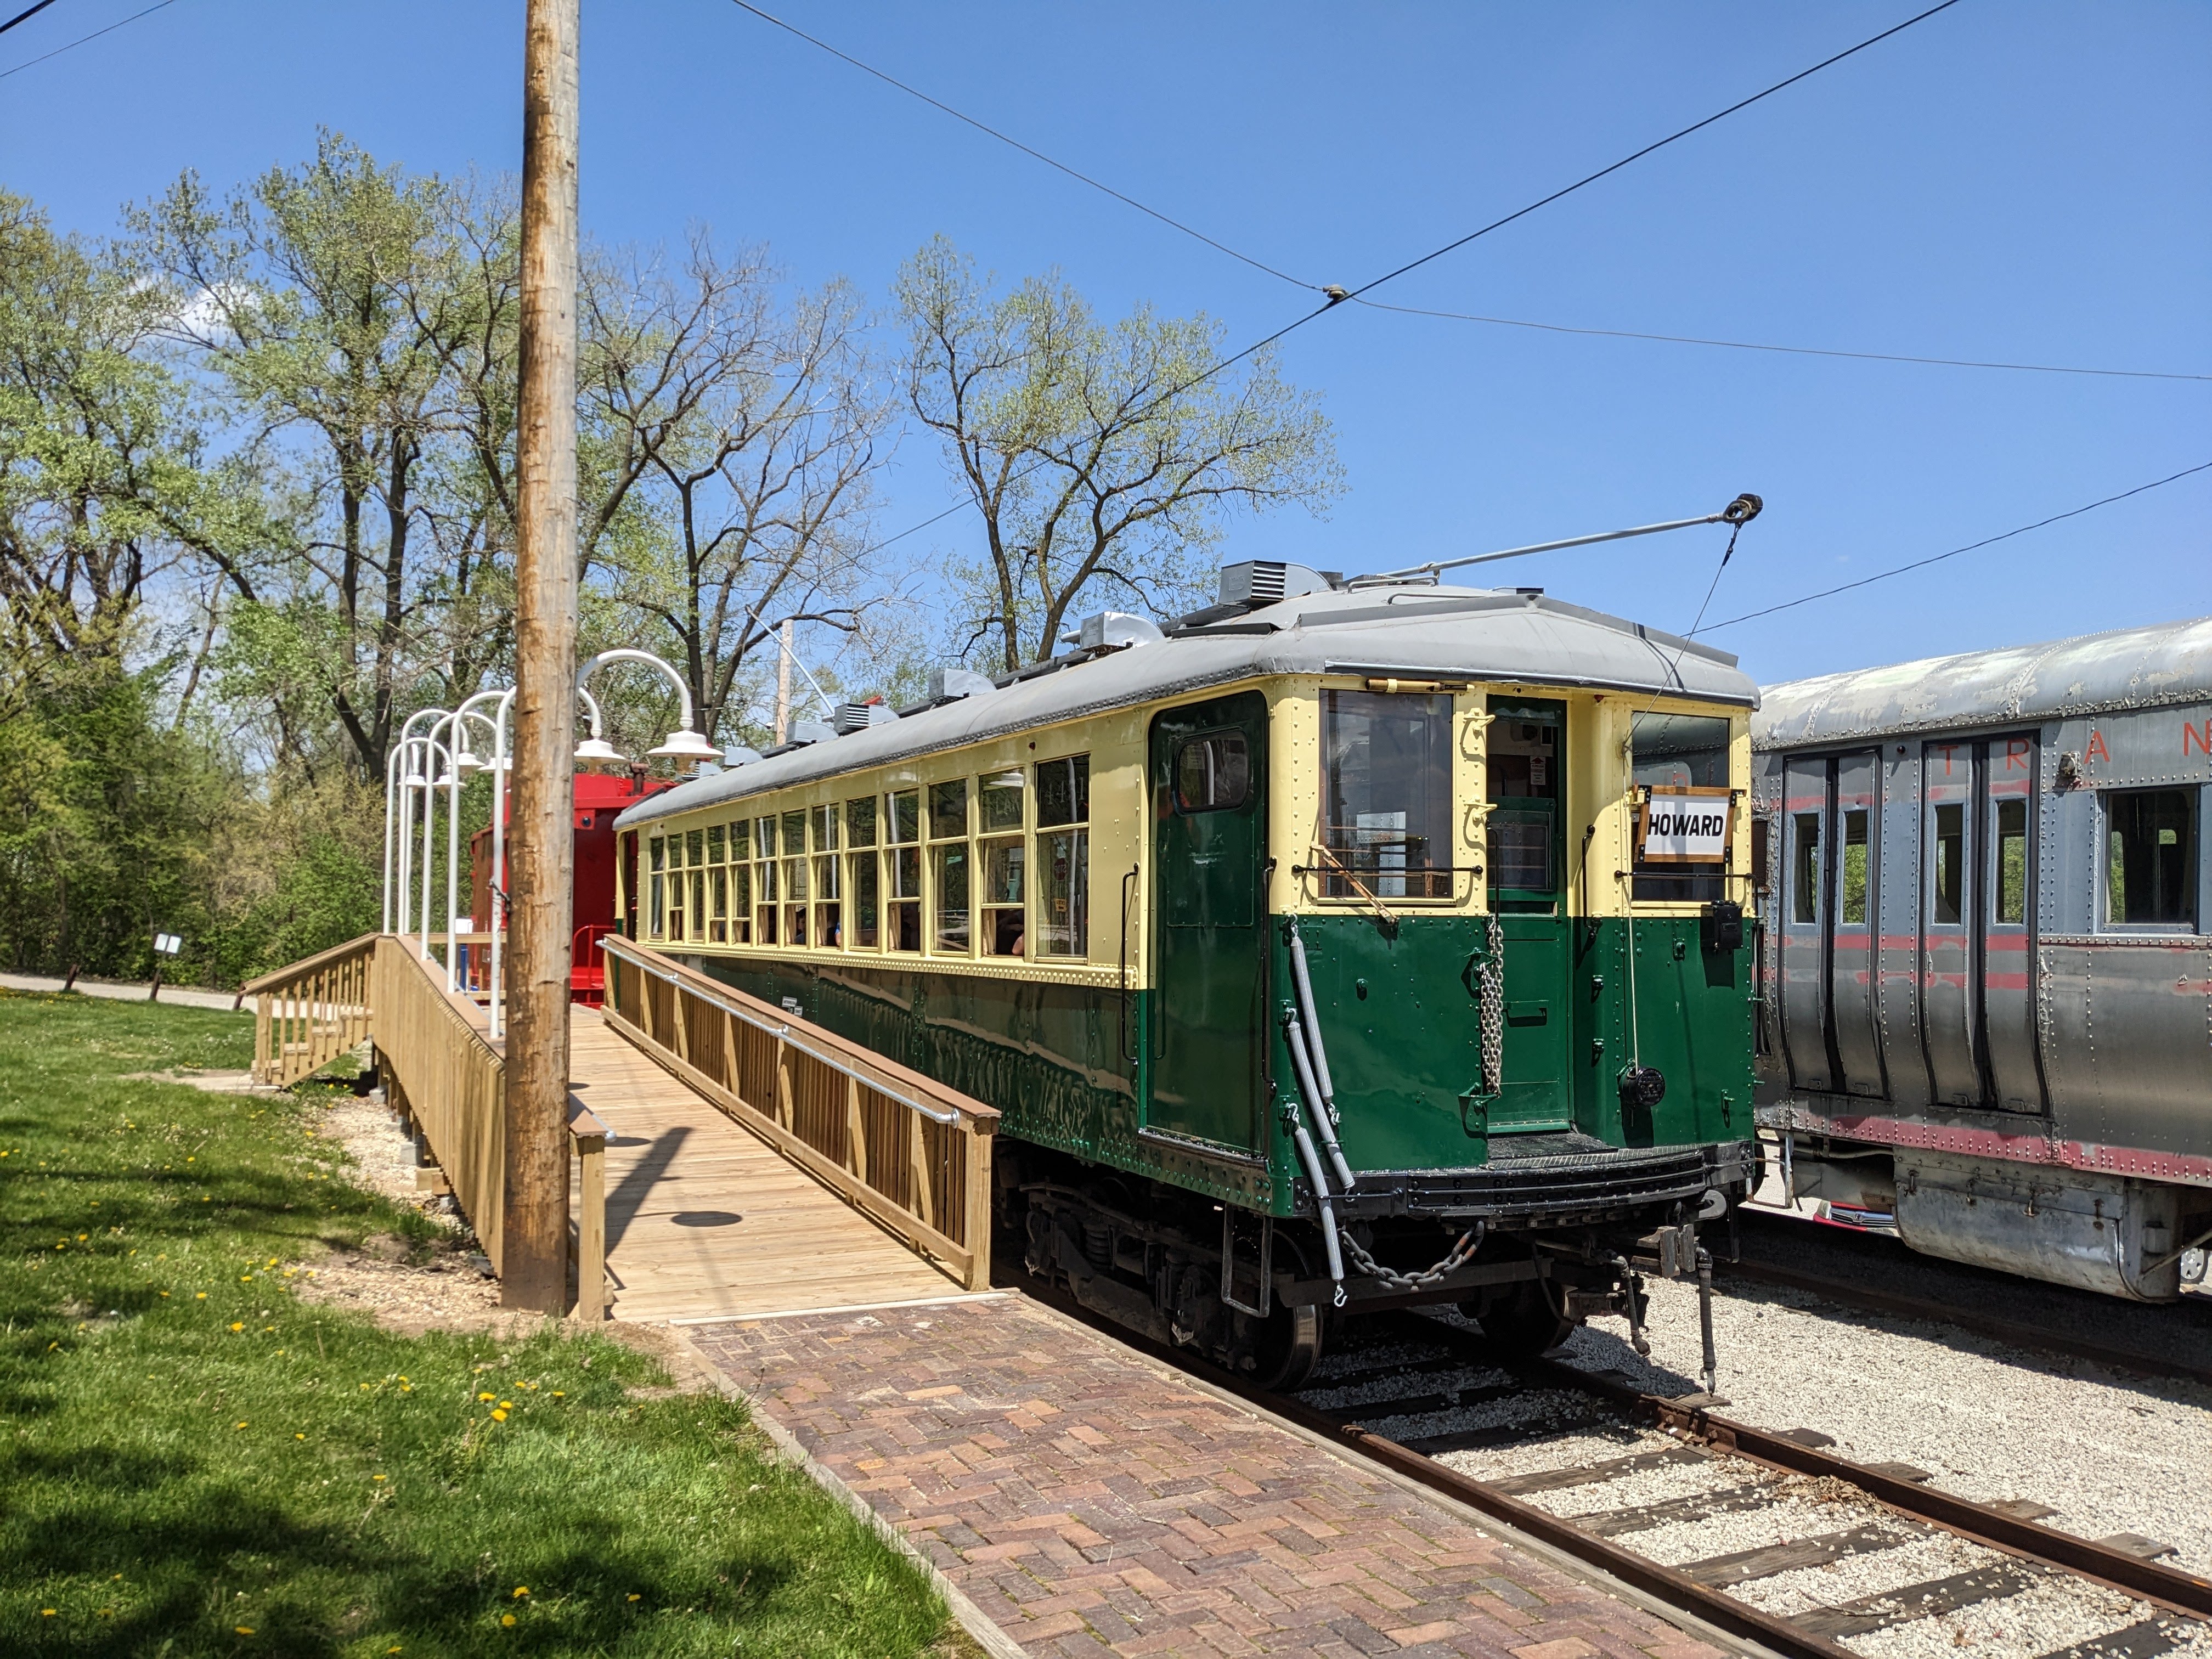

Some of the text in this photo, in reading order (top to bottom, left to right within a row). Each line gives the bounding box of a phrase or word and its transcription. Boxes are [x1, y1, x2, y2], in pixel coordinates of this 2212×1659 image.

[1938, 720, 2211, 776] TRAN
[1045, 776, 1085, 805] 441
[1647, 814, 1724, 837] HOWARD
